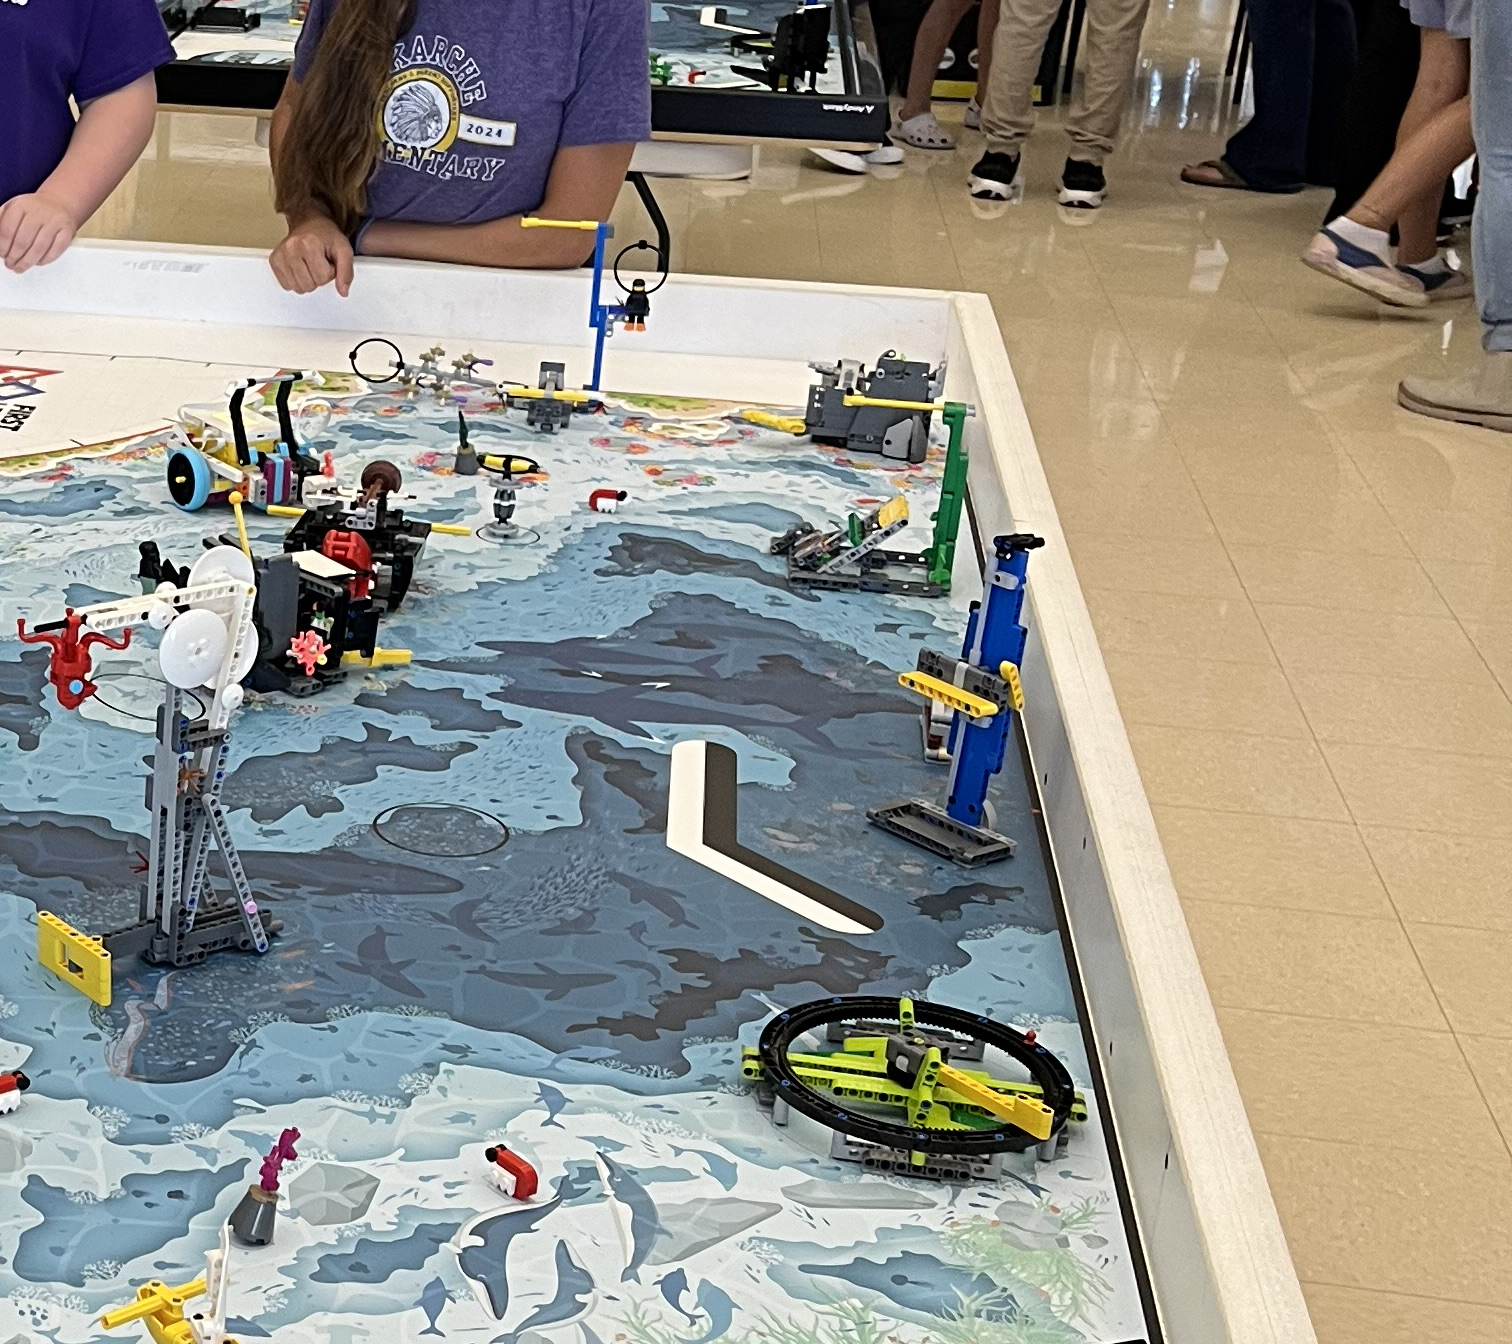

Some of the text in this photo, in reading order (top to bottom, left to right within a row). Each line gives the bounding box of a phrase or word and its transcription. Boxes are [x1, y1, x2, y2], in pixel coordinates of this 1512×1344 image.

[389, 35, 488, 107] KARCHE
[466, 123, 504, 139] 2024
[382, 140, 506, 182] ENTARY
